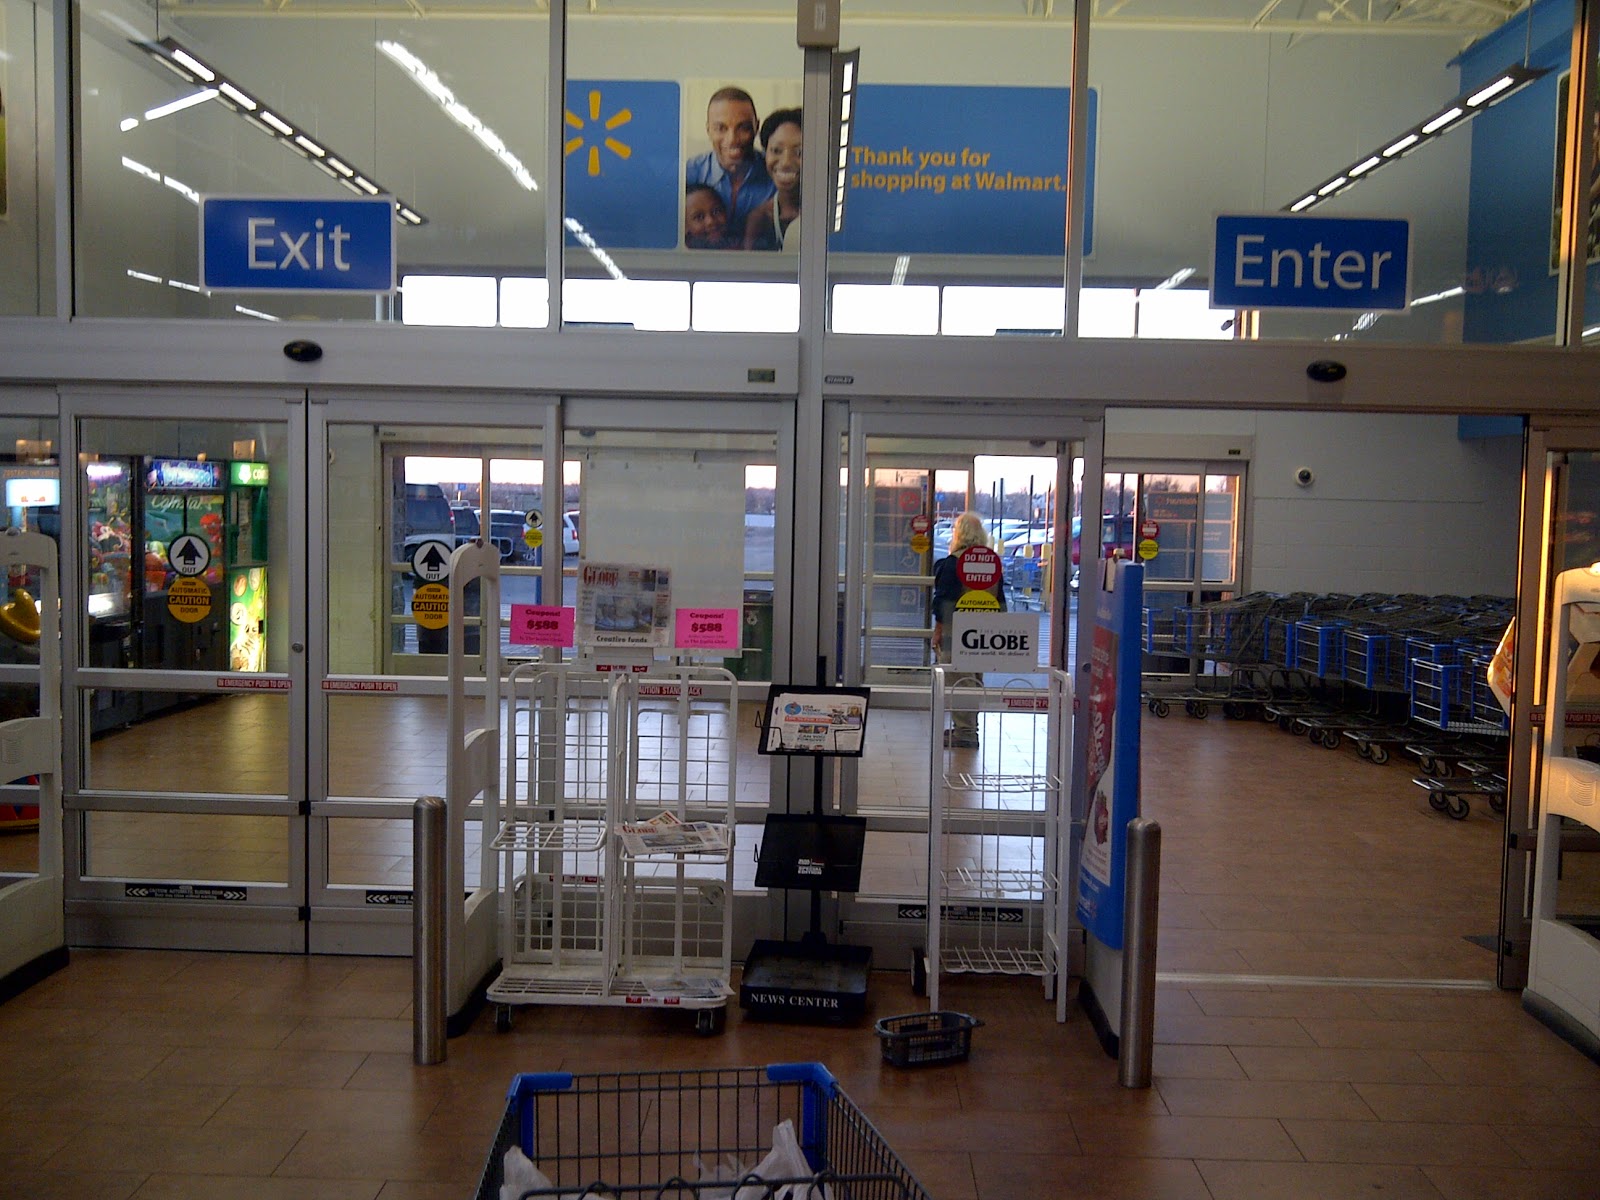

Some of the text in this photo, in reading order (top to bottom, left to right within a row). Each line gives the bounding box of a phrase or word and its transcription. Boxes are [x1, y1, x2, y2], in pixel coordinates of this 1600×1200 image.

[851, 146, 991, 170] Thank you for
[851, 170, 1067, 194] shopping at Walmart.
[248, 218, 350, 271] Exit
[1235, 234, 1392, 290] Enter
[978, 554, 995, 562] NOT
[966, 574, 992, 582] ENTER
[169, 596, 210, 605] CAUTION
[413, 602, 449, 611] CAUTIO
[525, 609, 561, 617] Coupons!
[527, 620, 559, 630] $588
[691, 622, 722, 633] $588
[596, 635, 626, 643] Creative
[961, 628, 1030, 650] GLOBE
[688, 687, 700, 695] ACK
[751, 993, 839, 1008] NEWS CENTER
